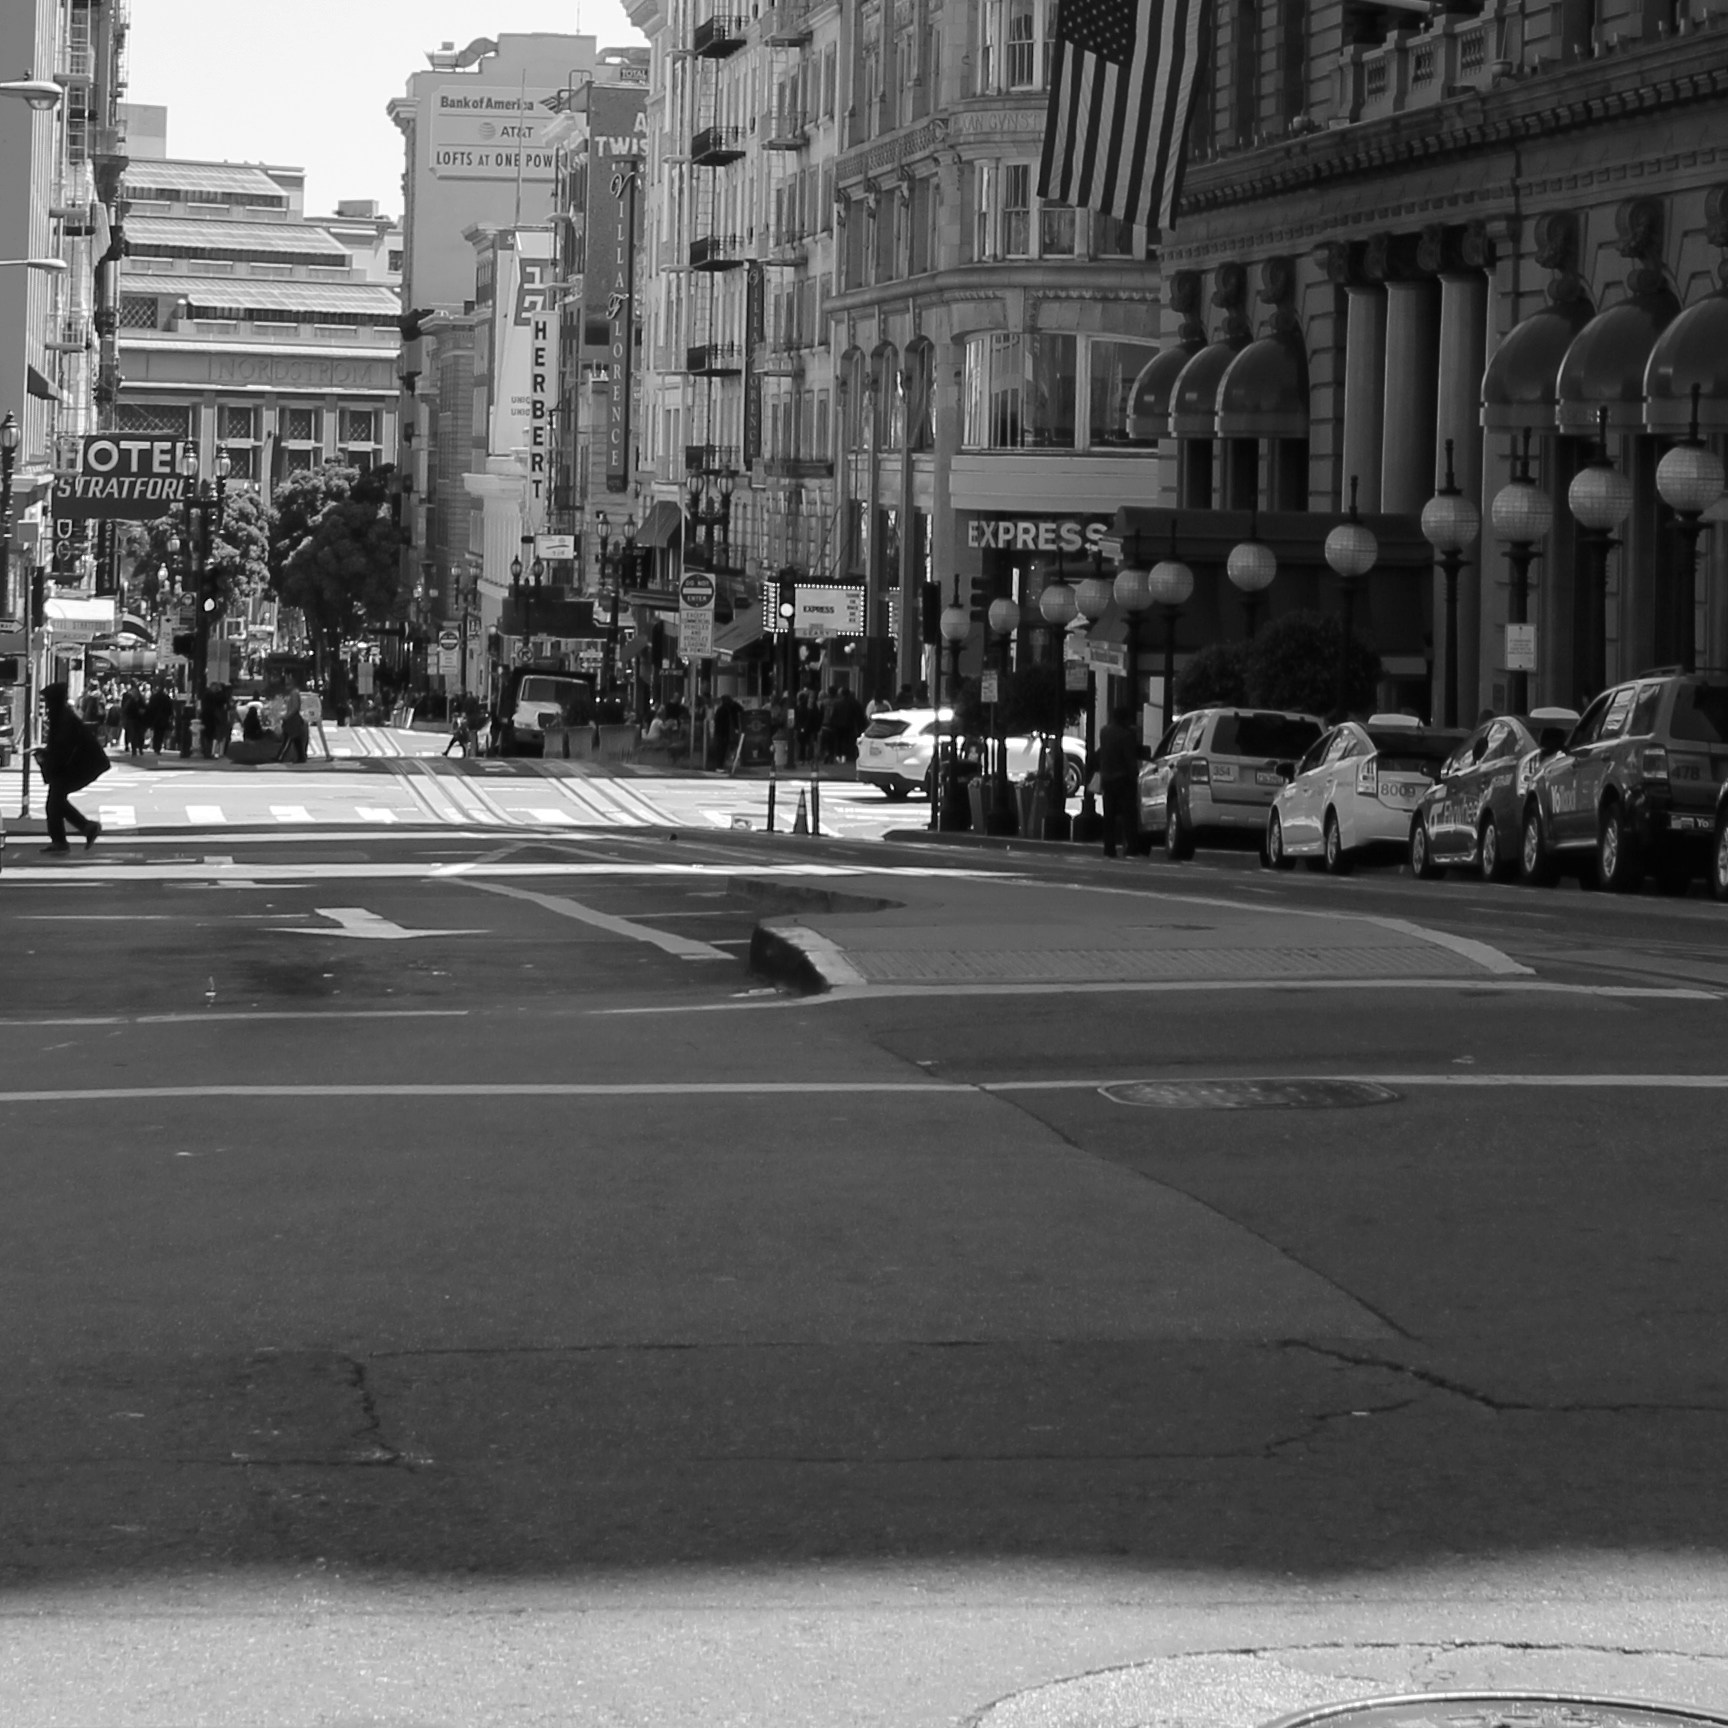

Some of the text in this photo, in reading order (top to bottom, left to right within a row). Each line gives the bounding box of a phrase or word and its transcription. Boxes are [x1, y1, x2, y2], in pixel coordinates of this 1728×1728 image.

[440, 95, 470, 110] Bank
[472, 96, 485, 110] of
[500, 125, 535, 139] AT&T
[436, 151, 473, 166] LOFTS
[478, 154, 491, 166] AT
[495, 153, 520, 168] ONE
[219, 359, 373, 384] NORDSTROM
[532, 320, 547, 499] HERBERT
[969, 519, 1109, 553] EXPRESS
[803, 605, 834, 614] EXPRESS
[1381, 784, 1416, 798] 8009
